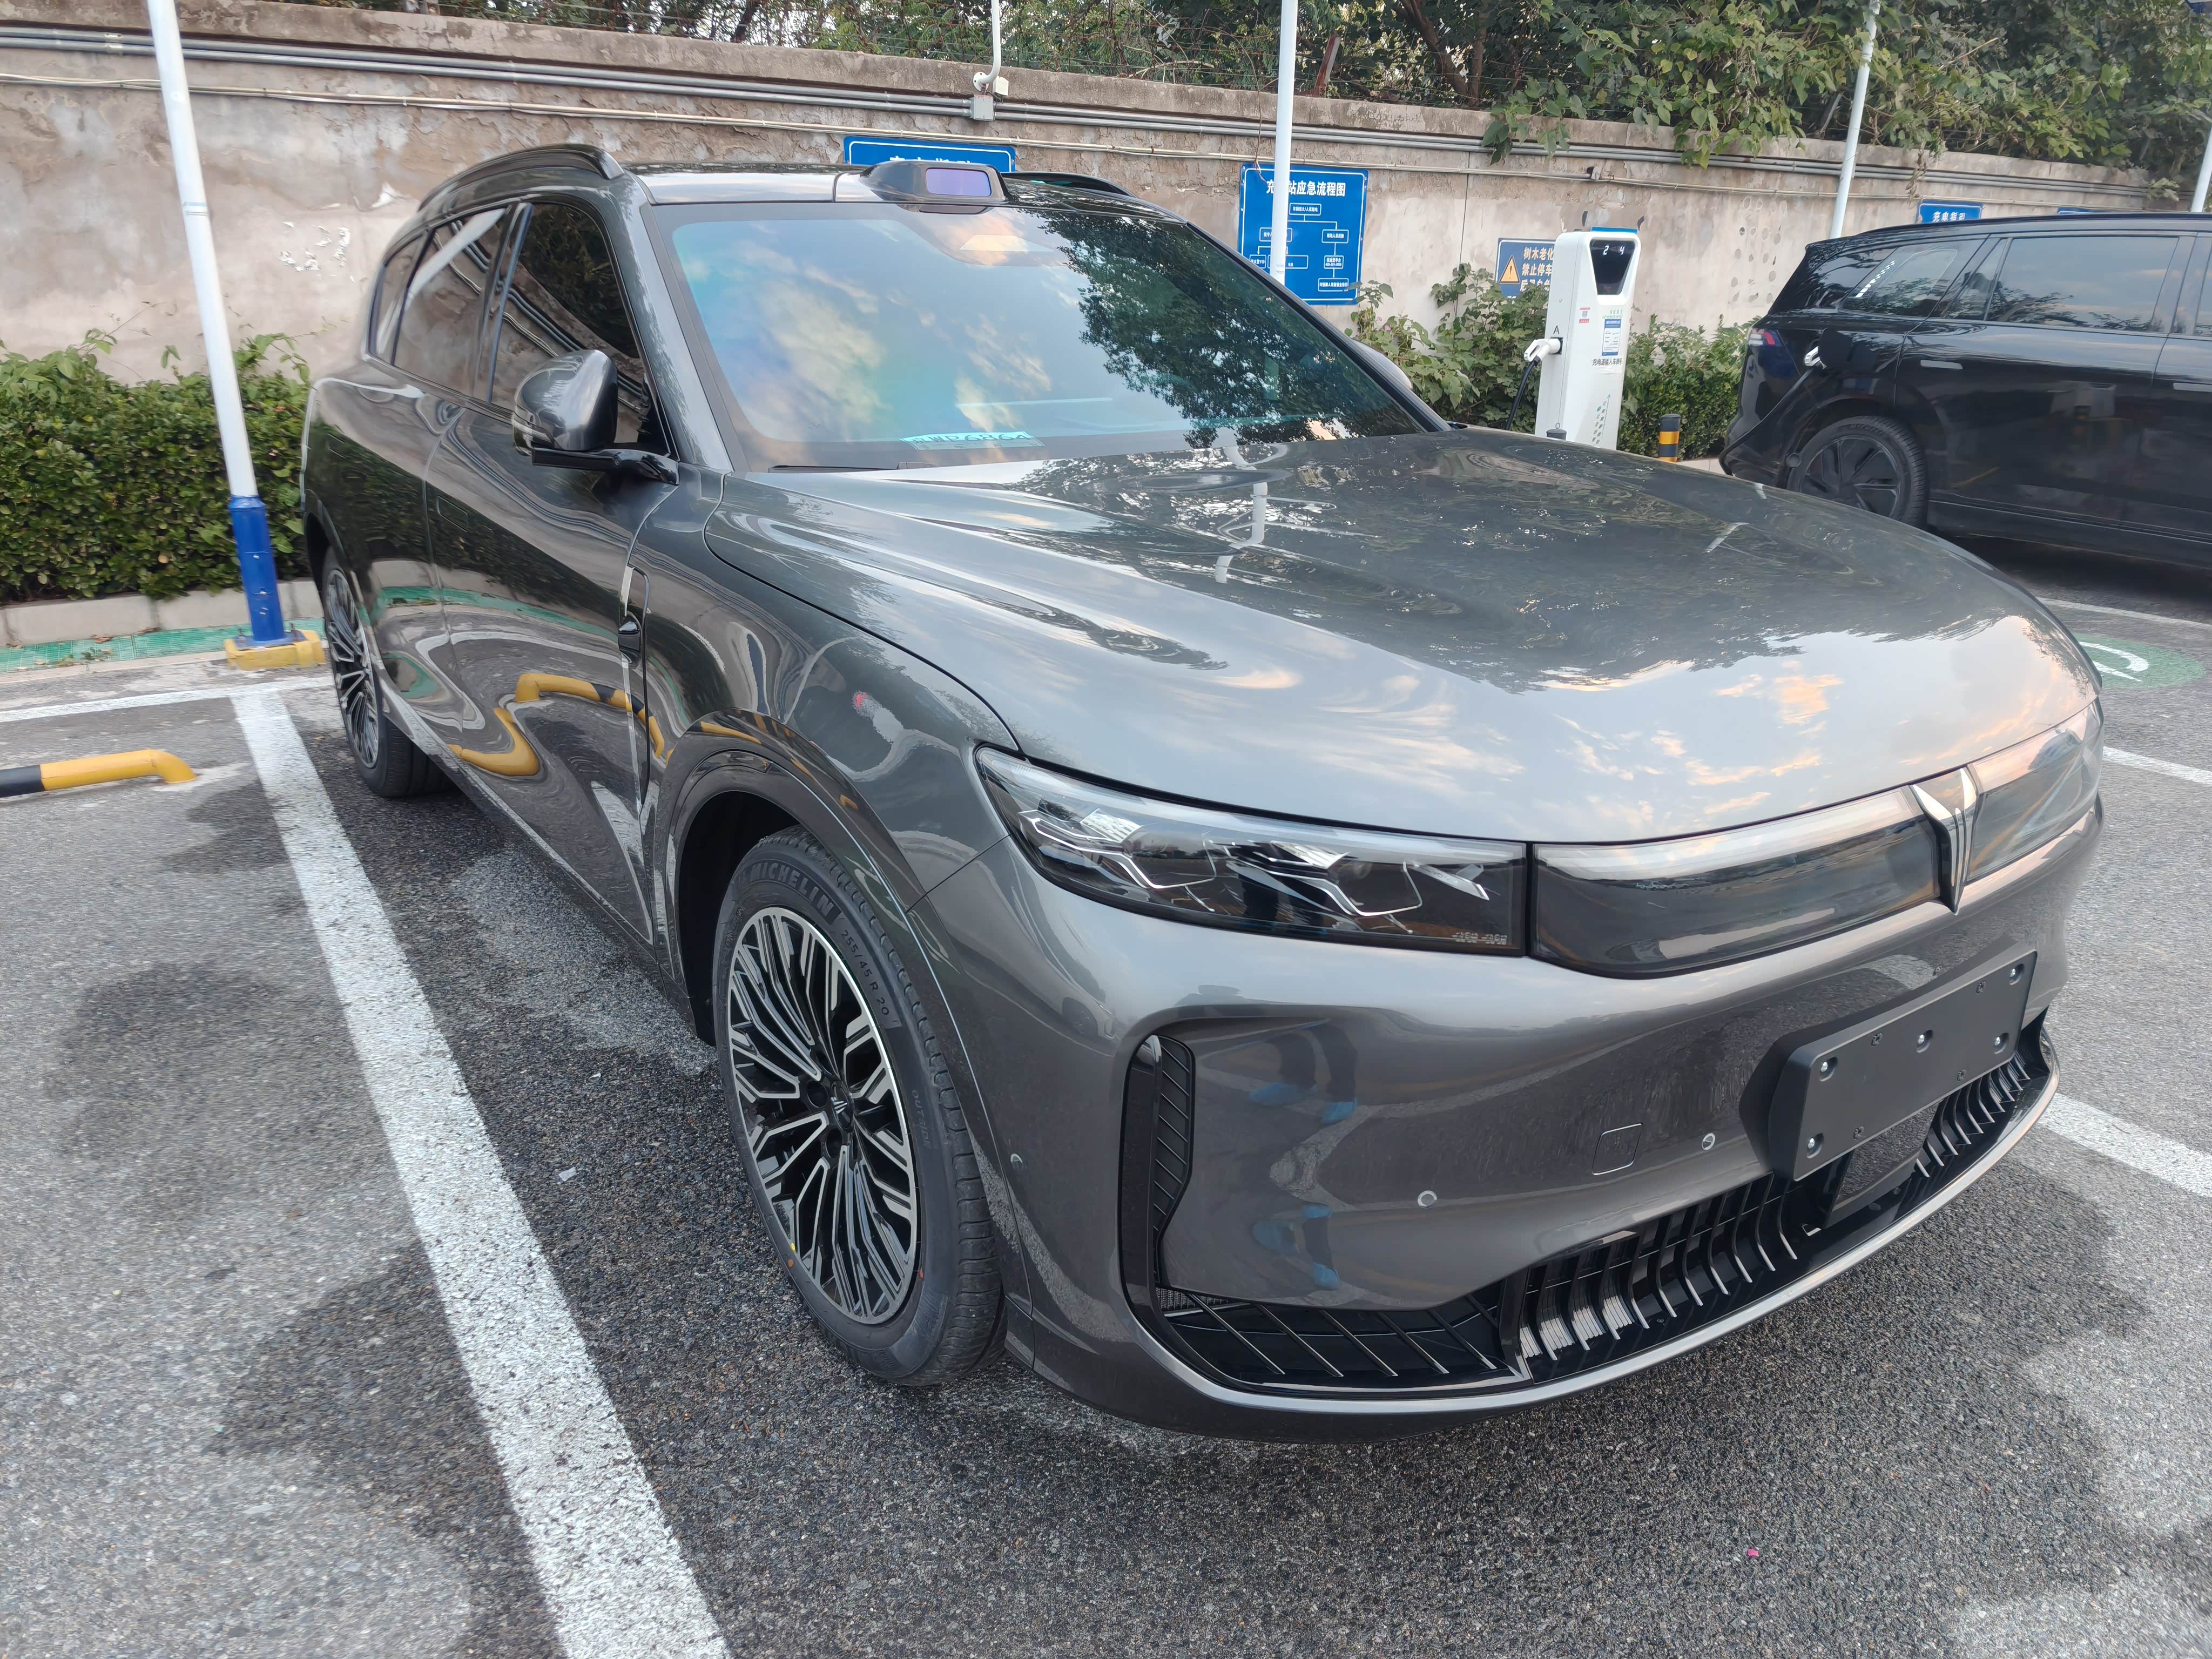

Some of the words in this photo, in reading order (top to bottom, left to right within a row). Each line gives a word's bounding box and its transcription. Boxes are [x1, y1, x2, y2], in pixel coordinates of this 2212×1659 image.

[1266, 180, 1346, 197] 充站应急流程图
[1523, 246, 1554, 260] 树木老化
[1522, 263, 1552, 276] 禁止停车
[1553, 326, 1560, 334] A
[751, 862, 834, 916] MICHELIN
[841, 930, 872, 978] 255/45
[868, 981, 879, 992] R
[875, 998, 889, 1016] 20
